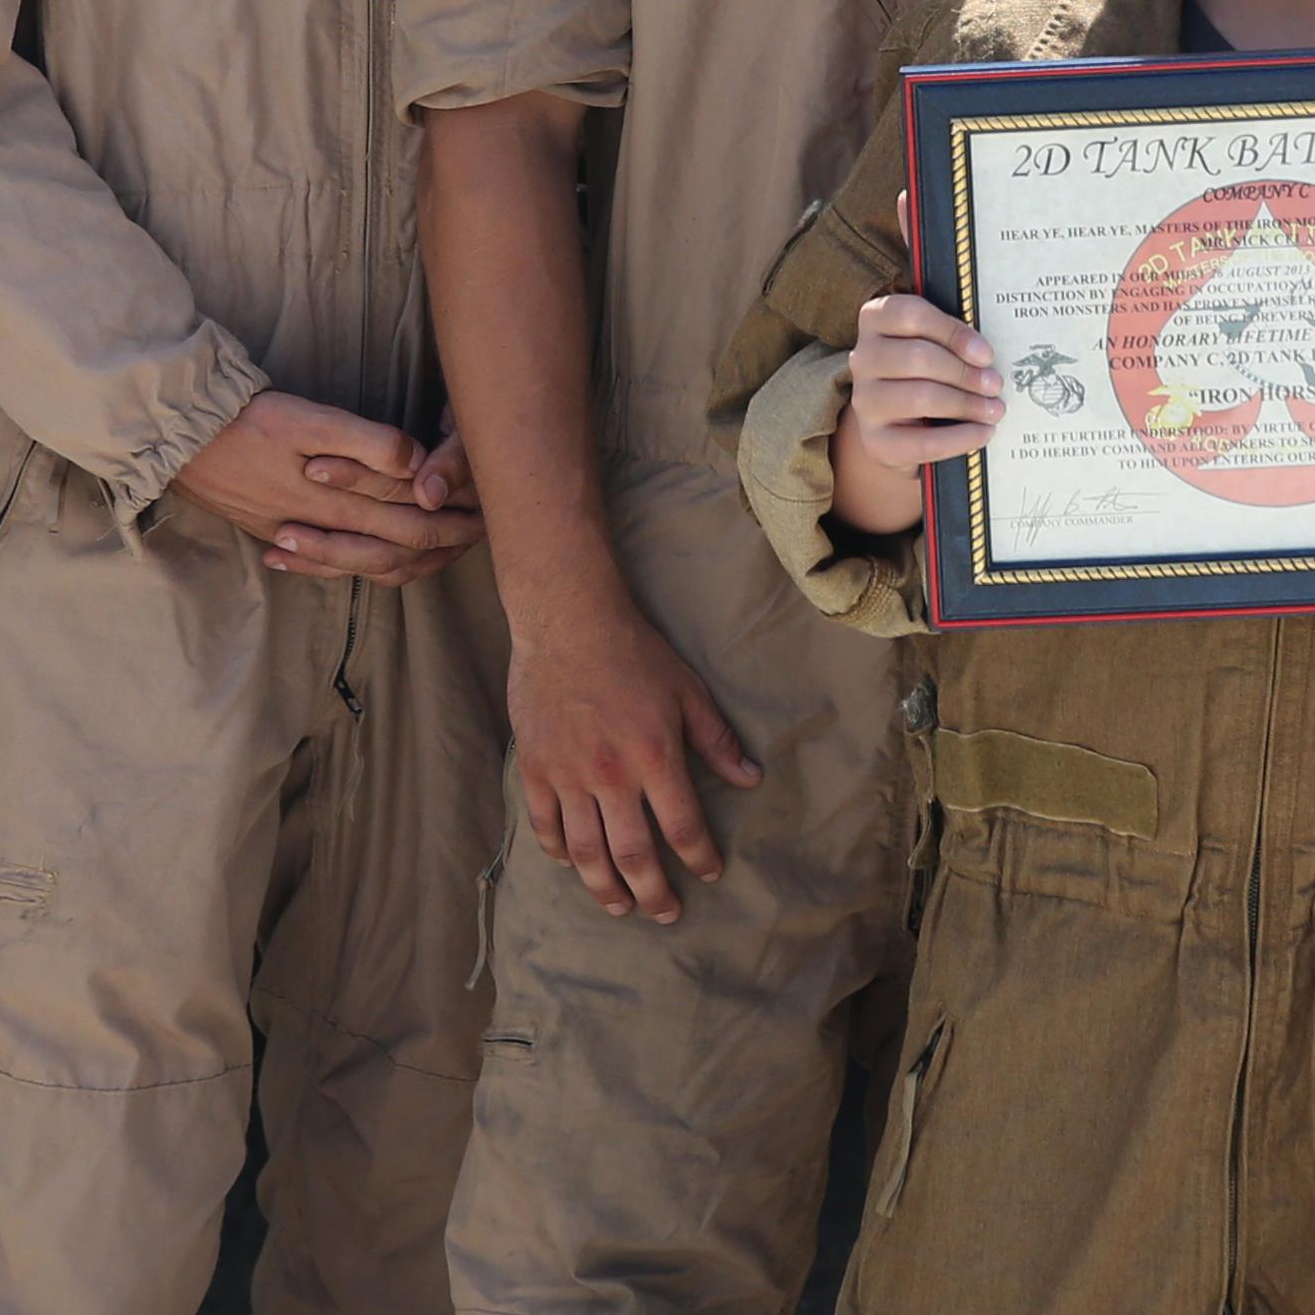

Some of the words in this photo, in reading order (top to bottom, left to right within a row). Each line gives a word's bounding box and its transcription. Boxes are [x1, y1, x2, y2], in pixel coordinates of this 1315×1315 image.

[1011, 143, 1071, 177] 2D
[1083, 136, 1221, 178] TANK
[1203, 183, 1295, 202] COMPANY
[1299, 182, 1311, 198] C
[1001, 229, 1038, 240] HEAR
[1042, 228, 1065, 240] YE,
[1068, 226, 1105, 237] HEAR
[1109, 224, 1131, 236] YE,
[1136, 222, 1199, 234] MASTERS
[1203, 220, 1220, 231] OF
[1225, 219, 1253, 230] THE
[1257, 218, 1291, 229] IRON
[1036, 274, 1108, 287] APPEARED
[1111, 273, 1126, 284] IN
[1130, 271, 1159, 283] OUR
[1229, 265, 1281, 278] AUGUST
[996, 290, 1086, 304] DISTINCTION
[1089, 289, 1106, 300] BY
[1111, 285, 1185, 298] ENGAGING
[1189, 284, 1203, 295] IN
[1207, 278, 1315, 295] OCCUPATIONAL
[1014, 307, 1048, 319] IRON
[1052, 304, 1126, 317] MONSTERS
[1133, 302, 1159, 313] AND
[1163, 301, 1190, 312] HAS
[1173, 316, 1191, 327] OF
[1195, 314, 1238, 325] BEING
[1092, 336, 1116, 350] AN
[1122, 332, 1219, 349] HONORARY
[1225, 327, 1313, 344] LIFETIME
[1109, 354, 1199, 369] COMPANY
[1257, 348, 1306, 363] TANK
[1023, 433, 1040, 444] BE
[1044, 432, 1058, 443] IT
[1061, 429, 1126, 442] FURTHER
[1232, 425, 1250, 435] BY
[1252, 421, 1305, 434] VIRTUE
[1020, 449, 1039, 458] DO
[1043, 446, 1097, 457] HEREBY
[1102, 442, 1175, 456] COMMAND
[1280, 437, 1298, 448] TO
[1119, 460, 1136, 470] TO
[1140, 458, 1169, 469] HIM
[1172, 456, 1210, 467] UPON
[1213, 453, 1284, 466] ENTERING
[1287, 450, 1315, 461] OUR
[1011, 518, 1062, 529] COMPANY
[1065, 516, 1134, 528] COMMANDER
